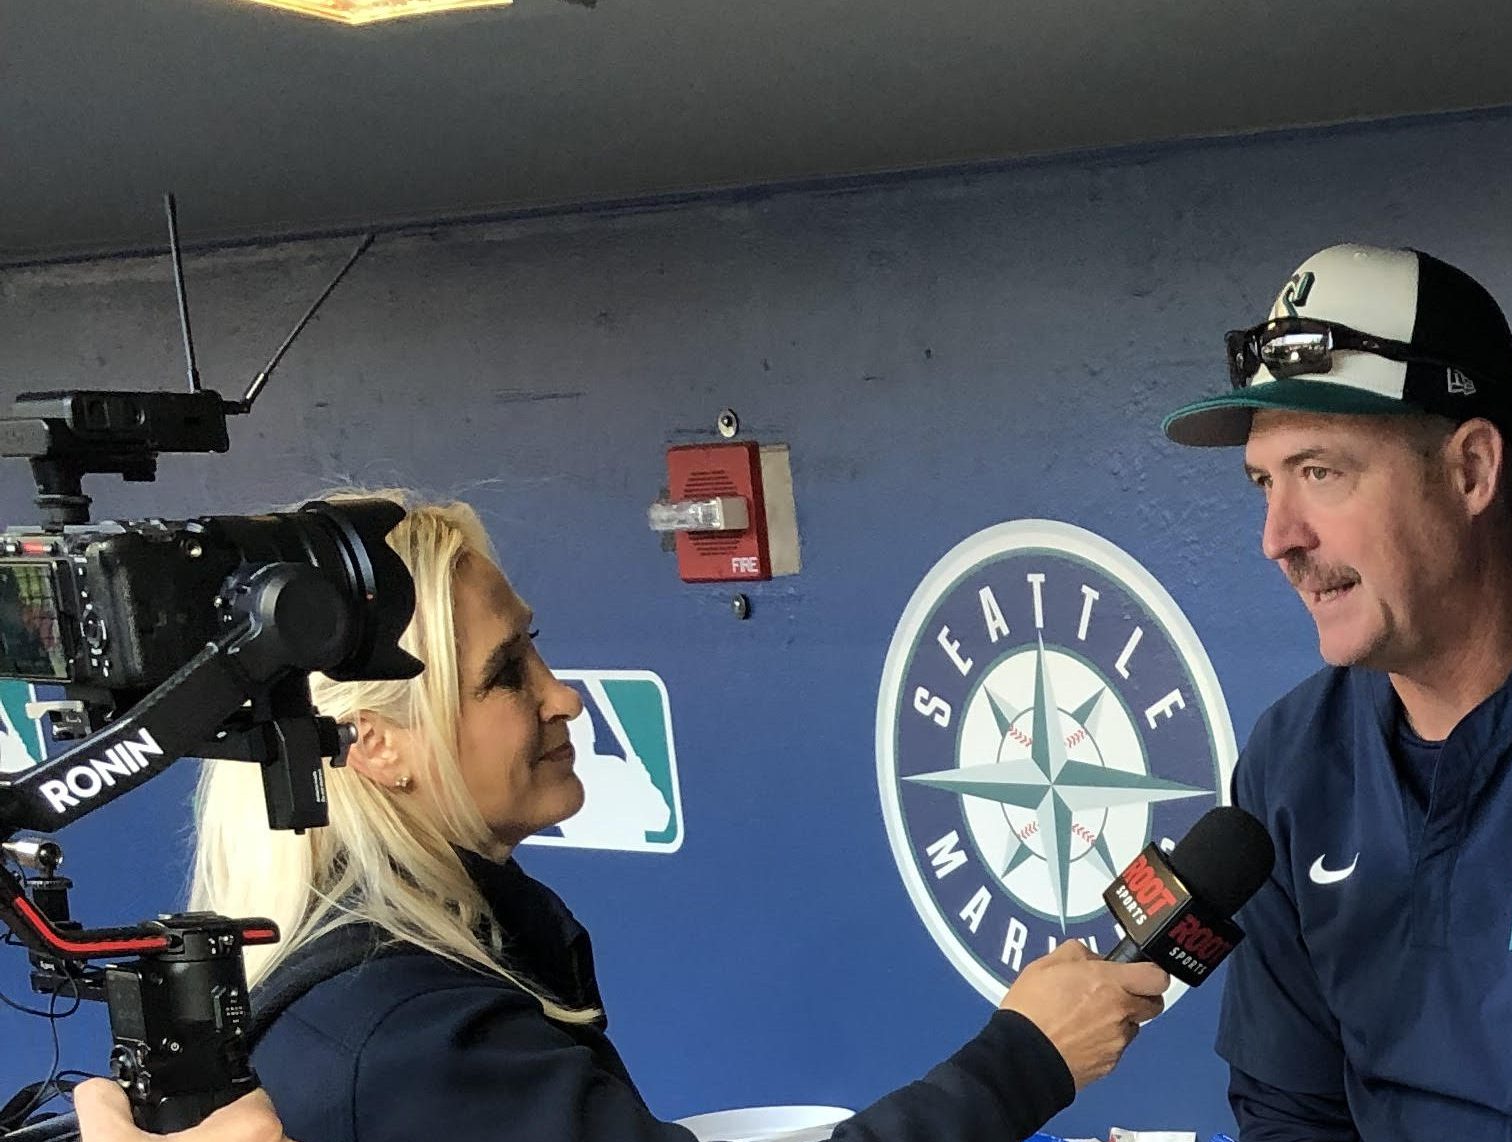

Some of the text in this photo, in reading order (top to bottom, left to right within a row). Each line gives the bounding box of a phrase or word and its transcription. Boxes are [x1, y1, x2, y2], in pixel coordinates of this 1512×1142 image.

[731, 556, 759, 574] FIRE
[912, 572, 1187, 730] SEATTLE
[38, 727, 165, 814] RONIN
[1115, 885, 1148, 926] SPORTS
[1122, 853, 1177, 916] ROOT
[1168, 946, 1208, 975] SPORTS
